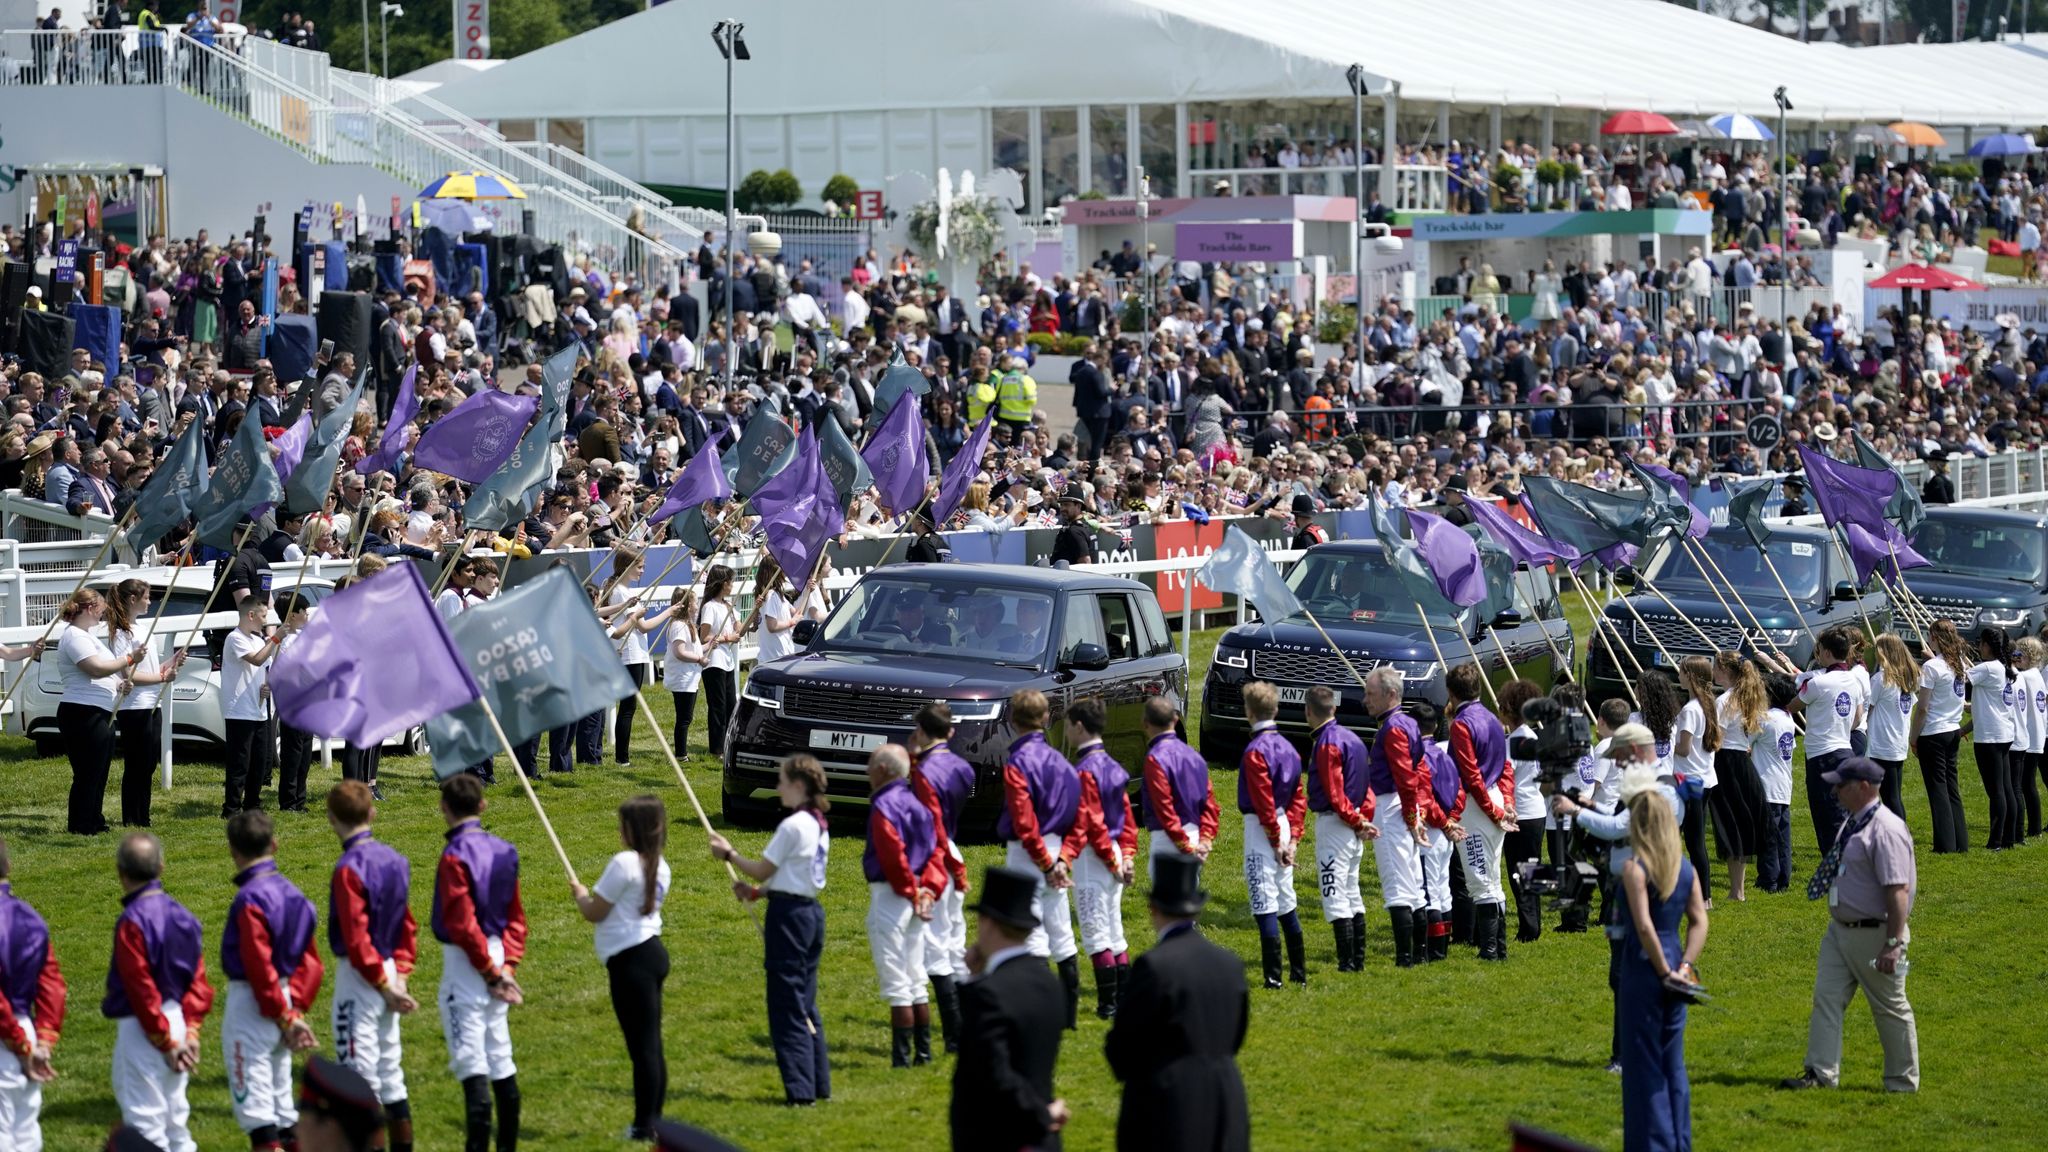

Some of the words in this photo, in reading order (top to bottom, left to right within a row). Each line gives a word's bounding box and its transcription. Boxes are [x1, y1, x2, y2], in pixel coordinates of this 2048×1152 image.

[861, 193, 879, 217] E
[1425, 221, 1482, 233] Trackside
[1485, 219, 1505, 231] bar
[1225, 231, 1243, 241] The
[1200, 243, 1247, 253] Trackside
[1250, 243, 1272, 252] Bars
[1751, 424, 1777, 442] 1/2
[1931, 596, 1973, 605] ROVER
[1264, 642, 1311, 652] RANGE
[1320, 647, 1370, 656] ROVER
[797, 678, 853, 689] RANGE
[863, 684, 923, 695] ROVER
[1465, 835, 1478, 867] ALBERT
[1472, 833, 1487, 876] BARTLETT
